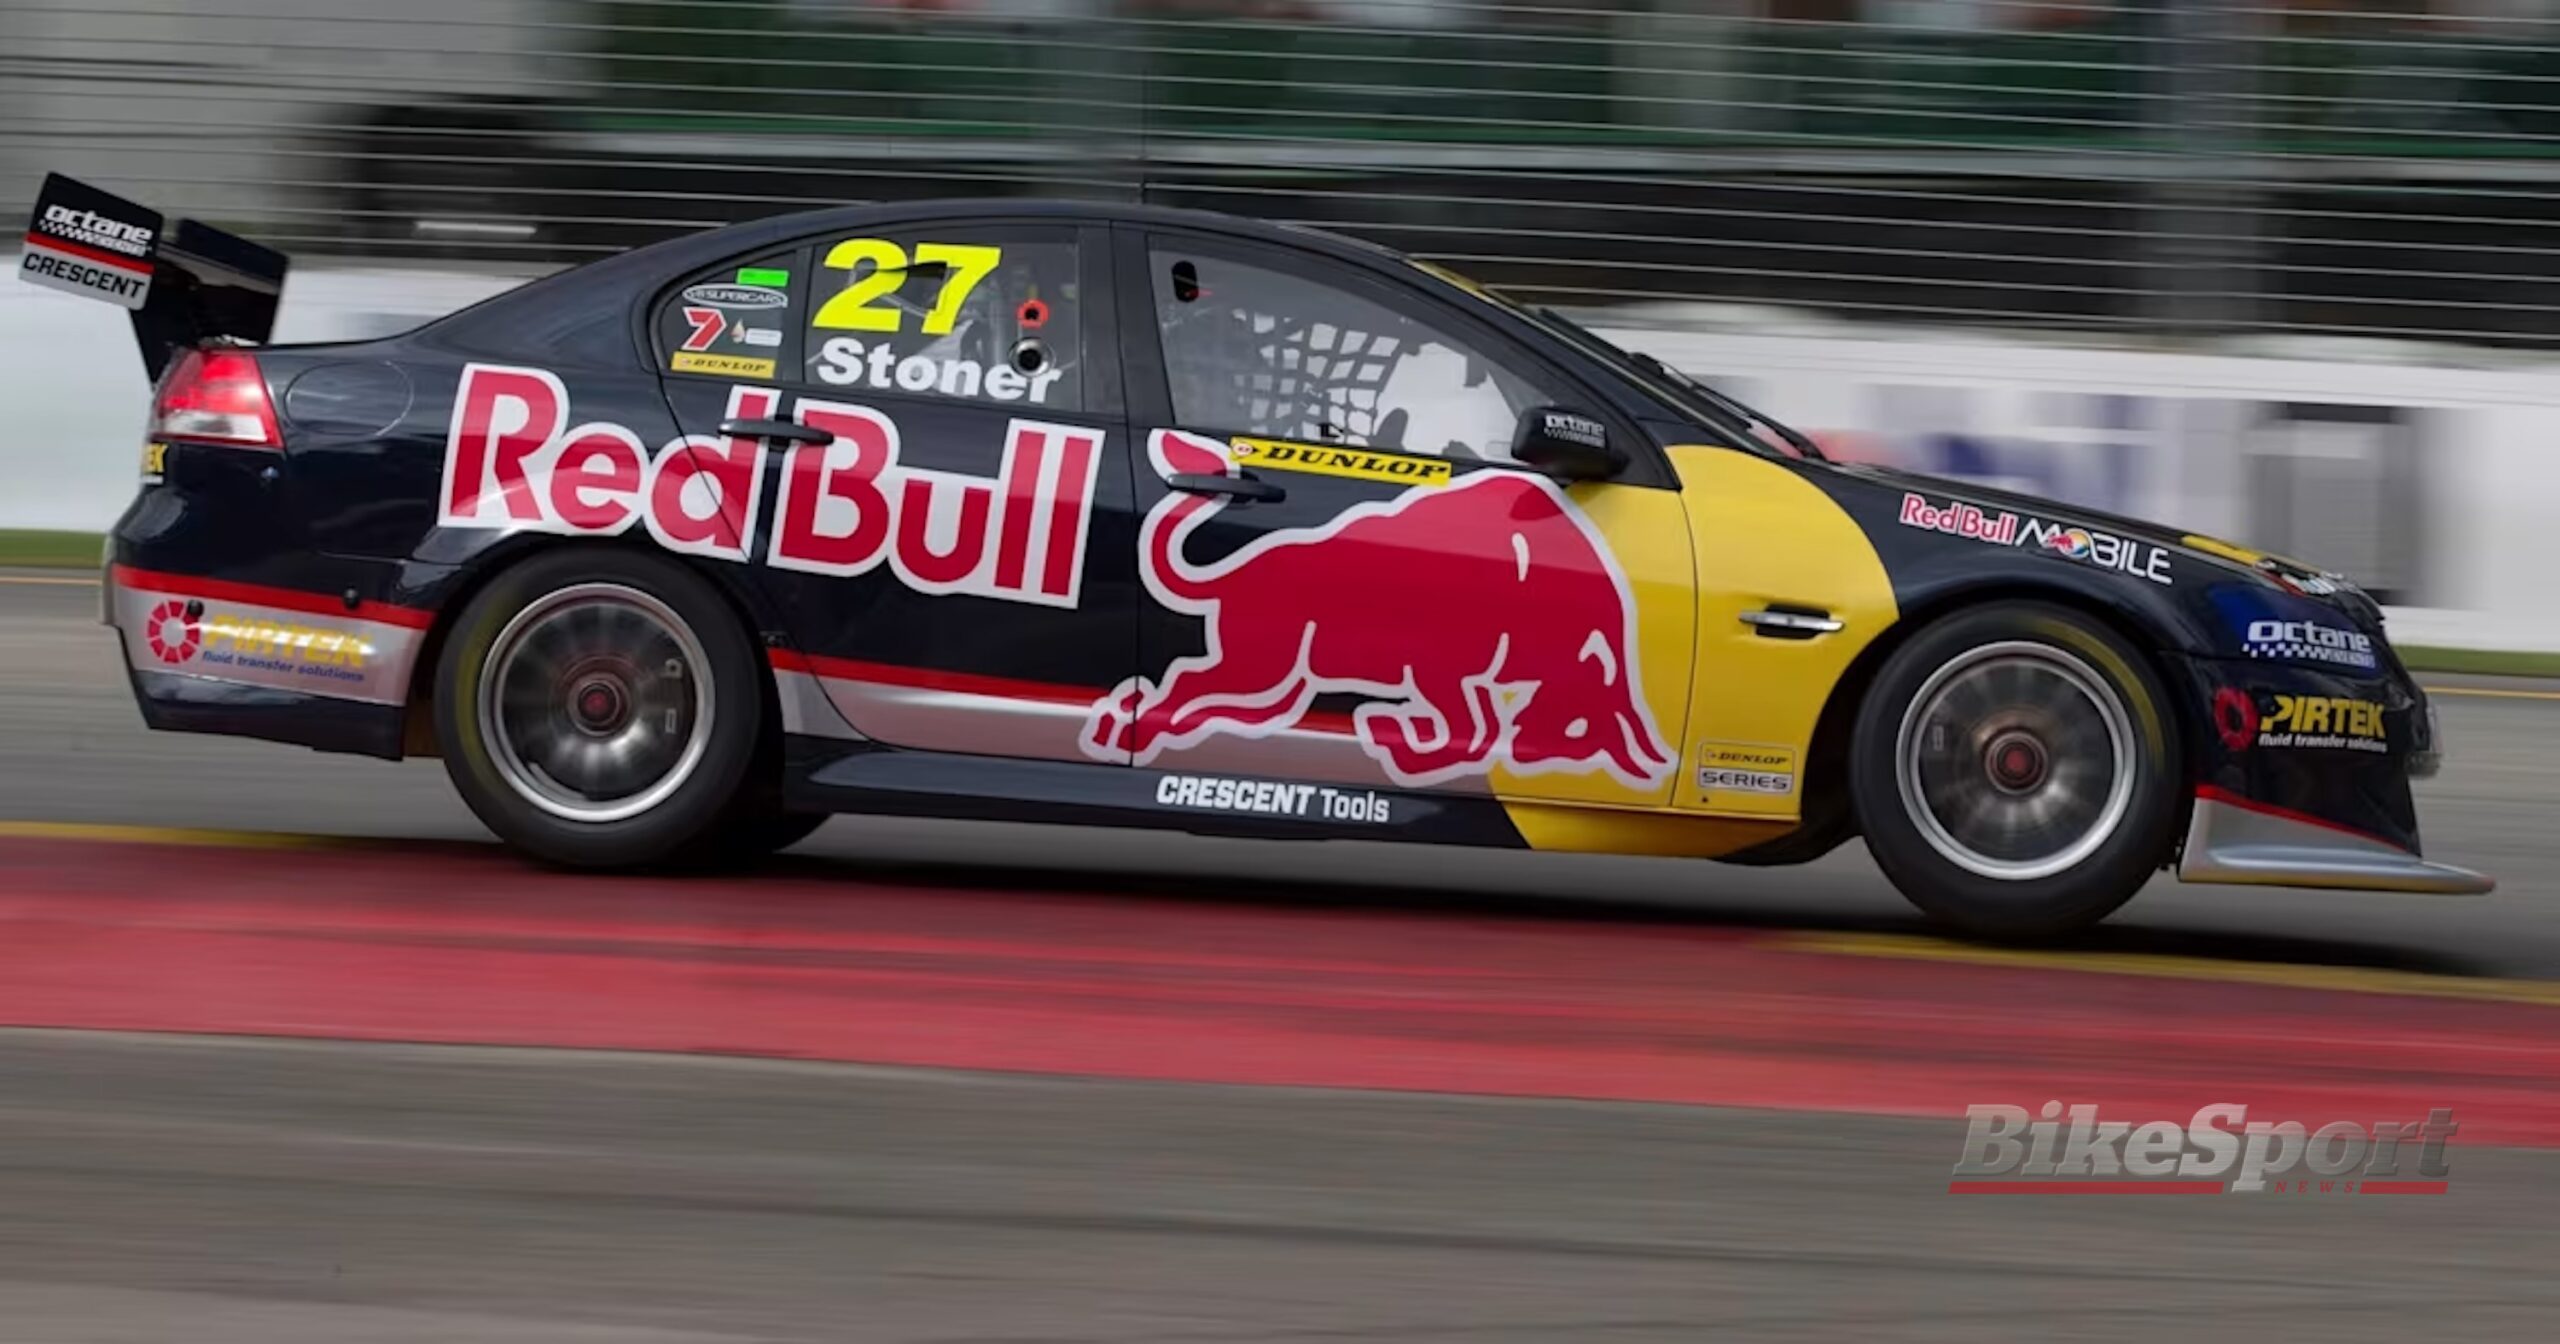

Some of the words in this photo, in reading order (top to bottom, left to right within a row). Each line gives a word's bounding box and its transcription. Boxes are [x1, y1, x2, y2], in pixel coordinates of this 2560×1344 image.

[44, 204, 153, 245] octane
[23, 252, 145, 299] CRESCENT
[812, 238, 1002, 334] 27
[681, 306, 727, 351] 7
[693, 359, 768, 372] DUNLOP
[816, 337, 1063, 403] Stoner
[1545, 414, 1605, 436] octane
[1263, 446, 1449, 478] DUNLOP
[438, 364, 780, 562] Red
[768, 398, 1106, 609] Bull
[2014, 518, 2173, 584] MOBILE
[203, 614, 374, 668] PIRTEK
[2248, 620, 2371, 652] octane
[202, 650, 233, 664] fluid
[237, 656, 294, 674] transfer
[298, 664, 365, 682] solutions
[2260, 695, 2386, 738] PIRTEK
[1719, 752, 1788, 765] DUNLOP
[2258, 733, 2292, 746] fluid
[2295, 734, 2346, 748] transfer
[1157, 775, 1316, 815] CRESCENT
[1320, 788, 1390, 823] Tools
[1702, 771, 1787, 790] SERIES
